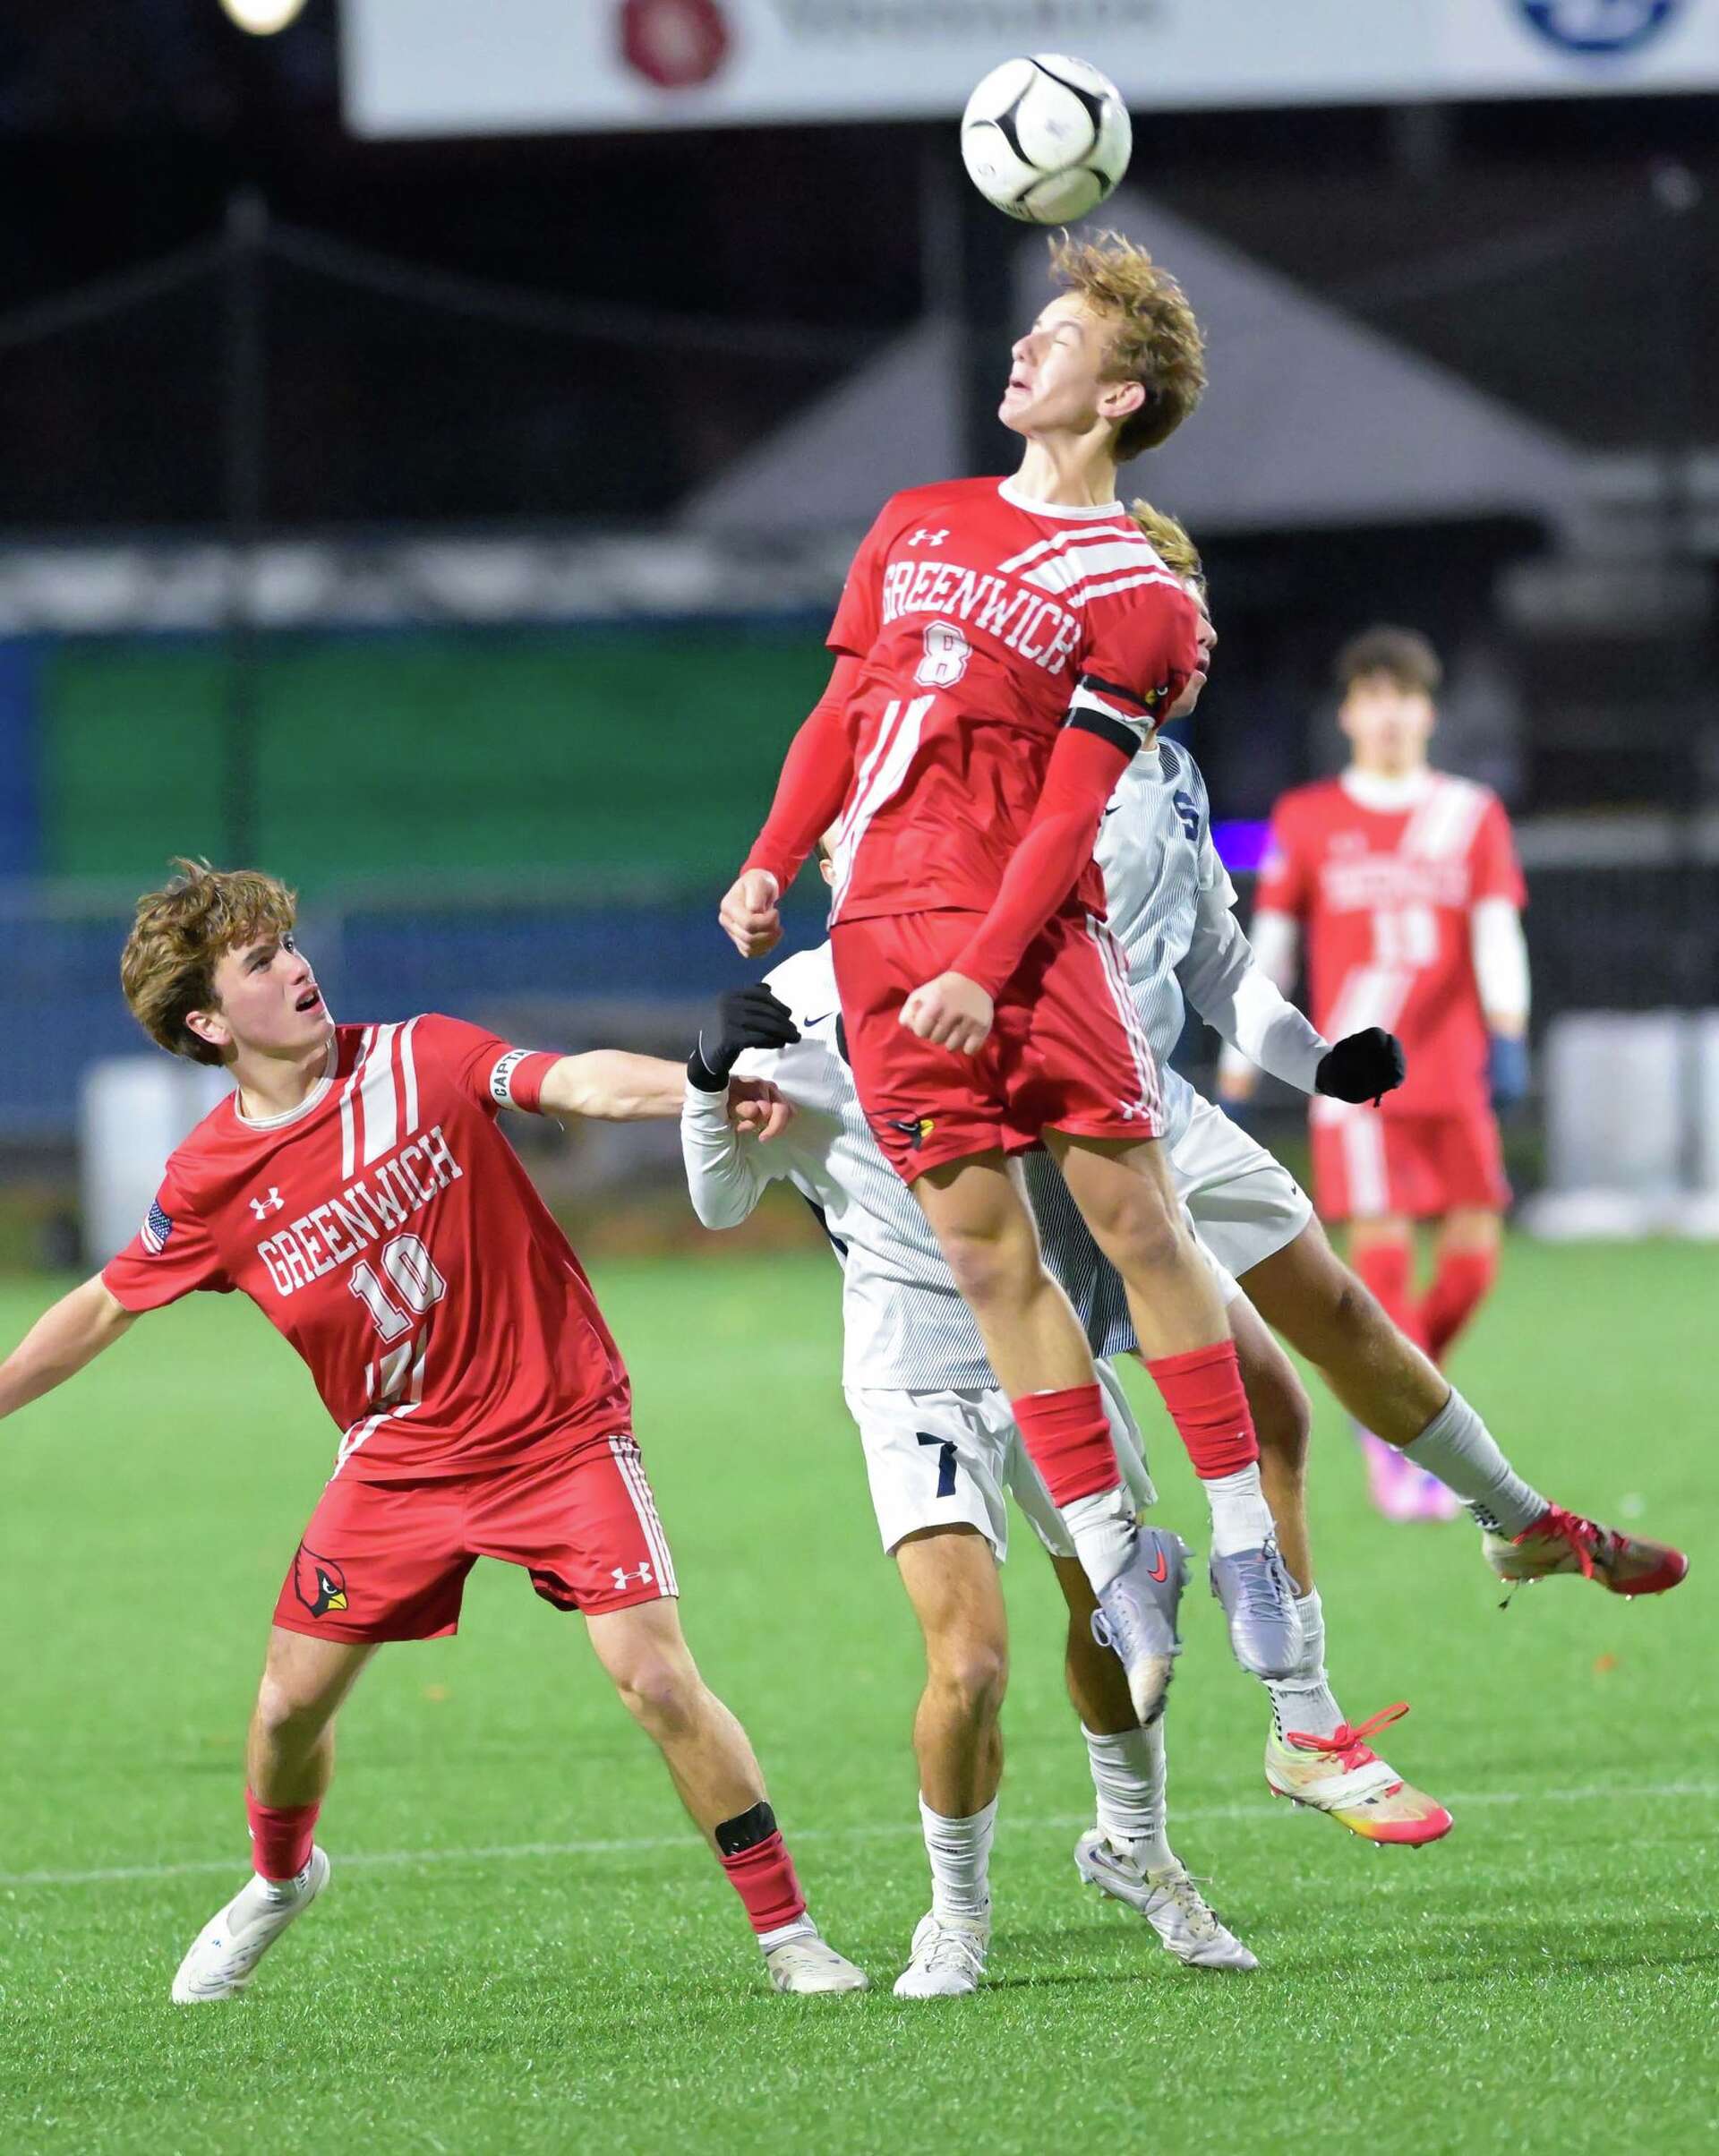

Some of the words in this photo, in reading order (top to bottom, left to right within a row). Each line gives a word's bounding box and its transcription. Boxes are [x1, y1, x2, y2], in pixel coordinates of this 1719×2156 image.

[883, 560, 1082, 674] GREENWICH
[913, 620, 973, 689] 8
[257, 1125, 464, 1296] GREENWICH
[347, 1233, 447, 1344] 10
[916, 1432, 958, 1498] 7
